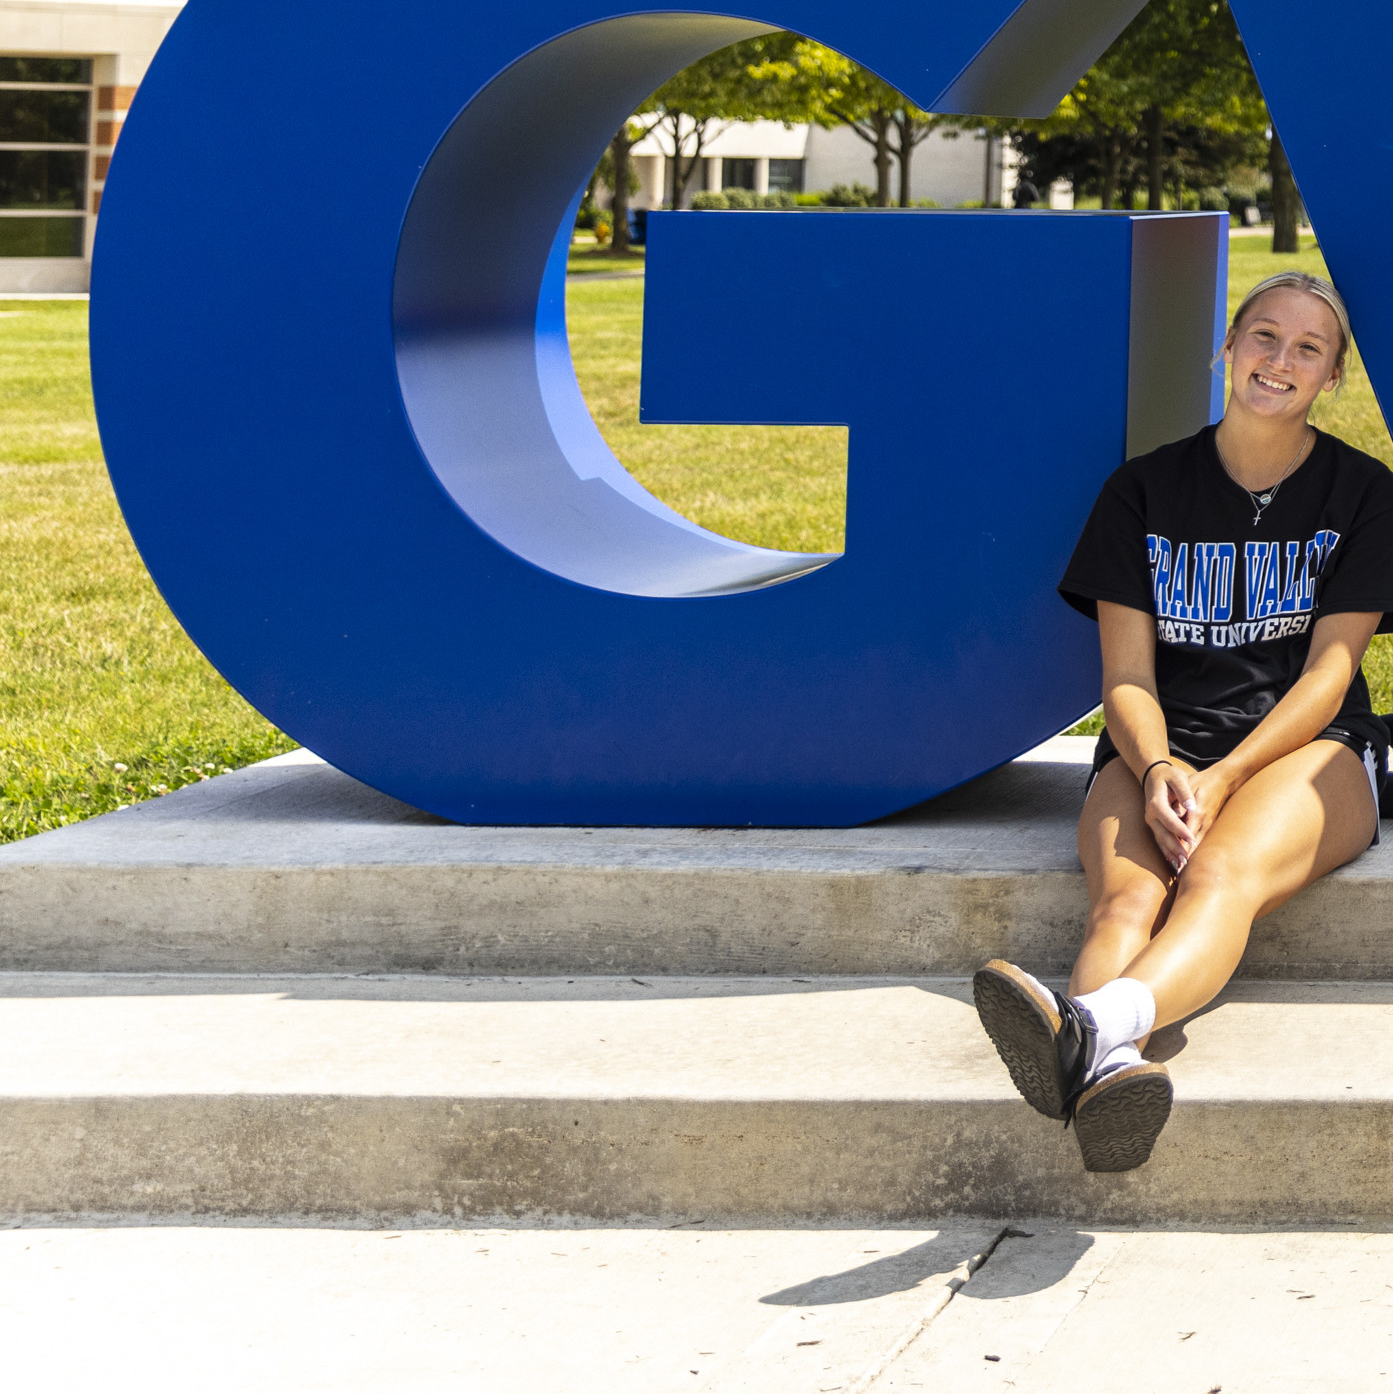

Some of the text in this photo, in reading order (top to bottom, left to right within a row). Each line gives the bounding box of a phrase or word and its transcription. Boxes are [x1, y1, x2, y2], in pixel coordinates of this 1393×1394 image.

[1244, 529, 1341, 622] VALLY
[1157, 614, 1312, 648] TATE UNIVERSI
